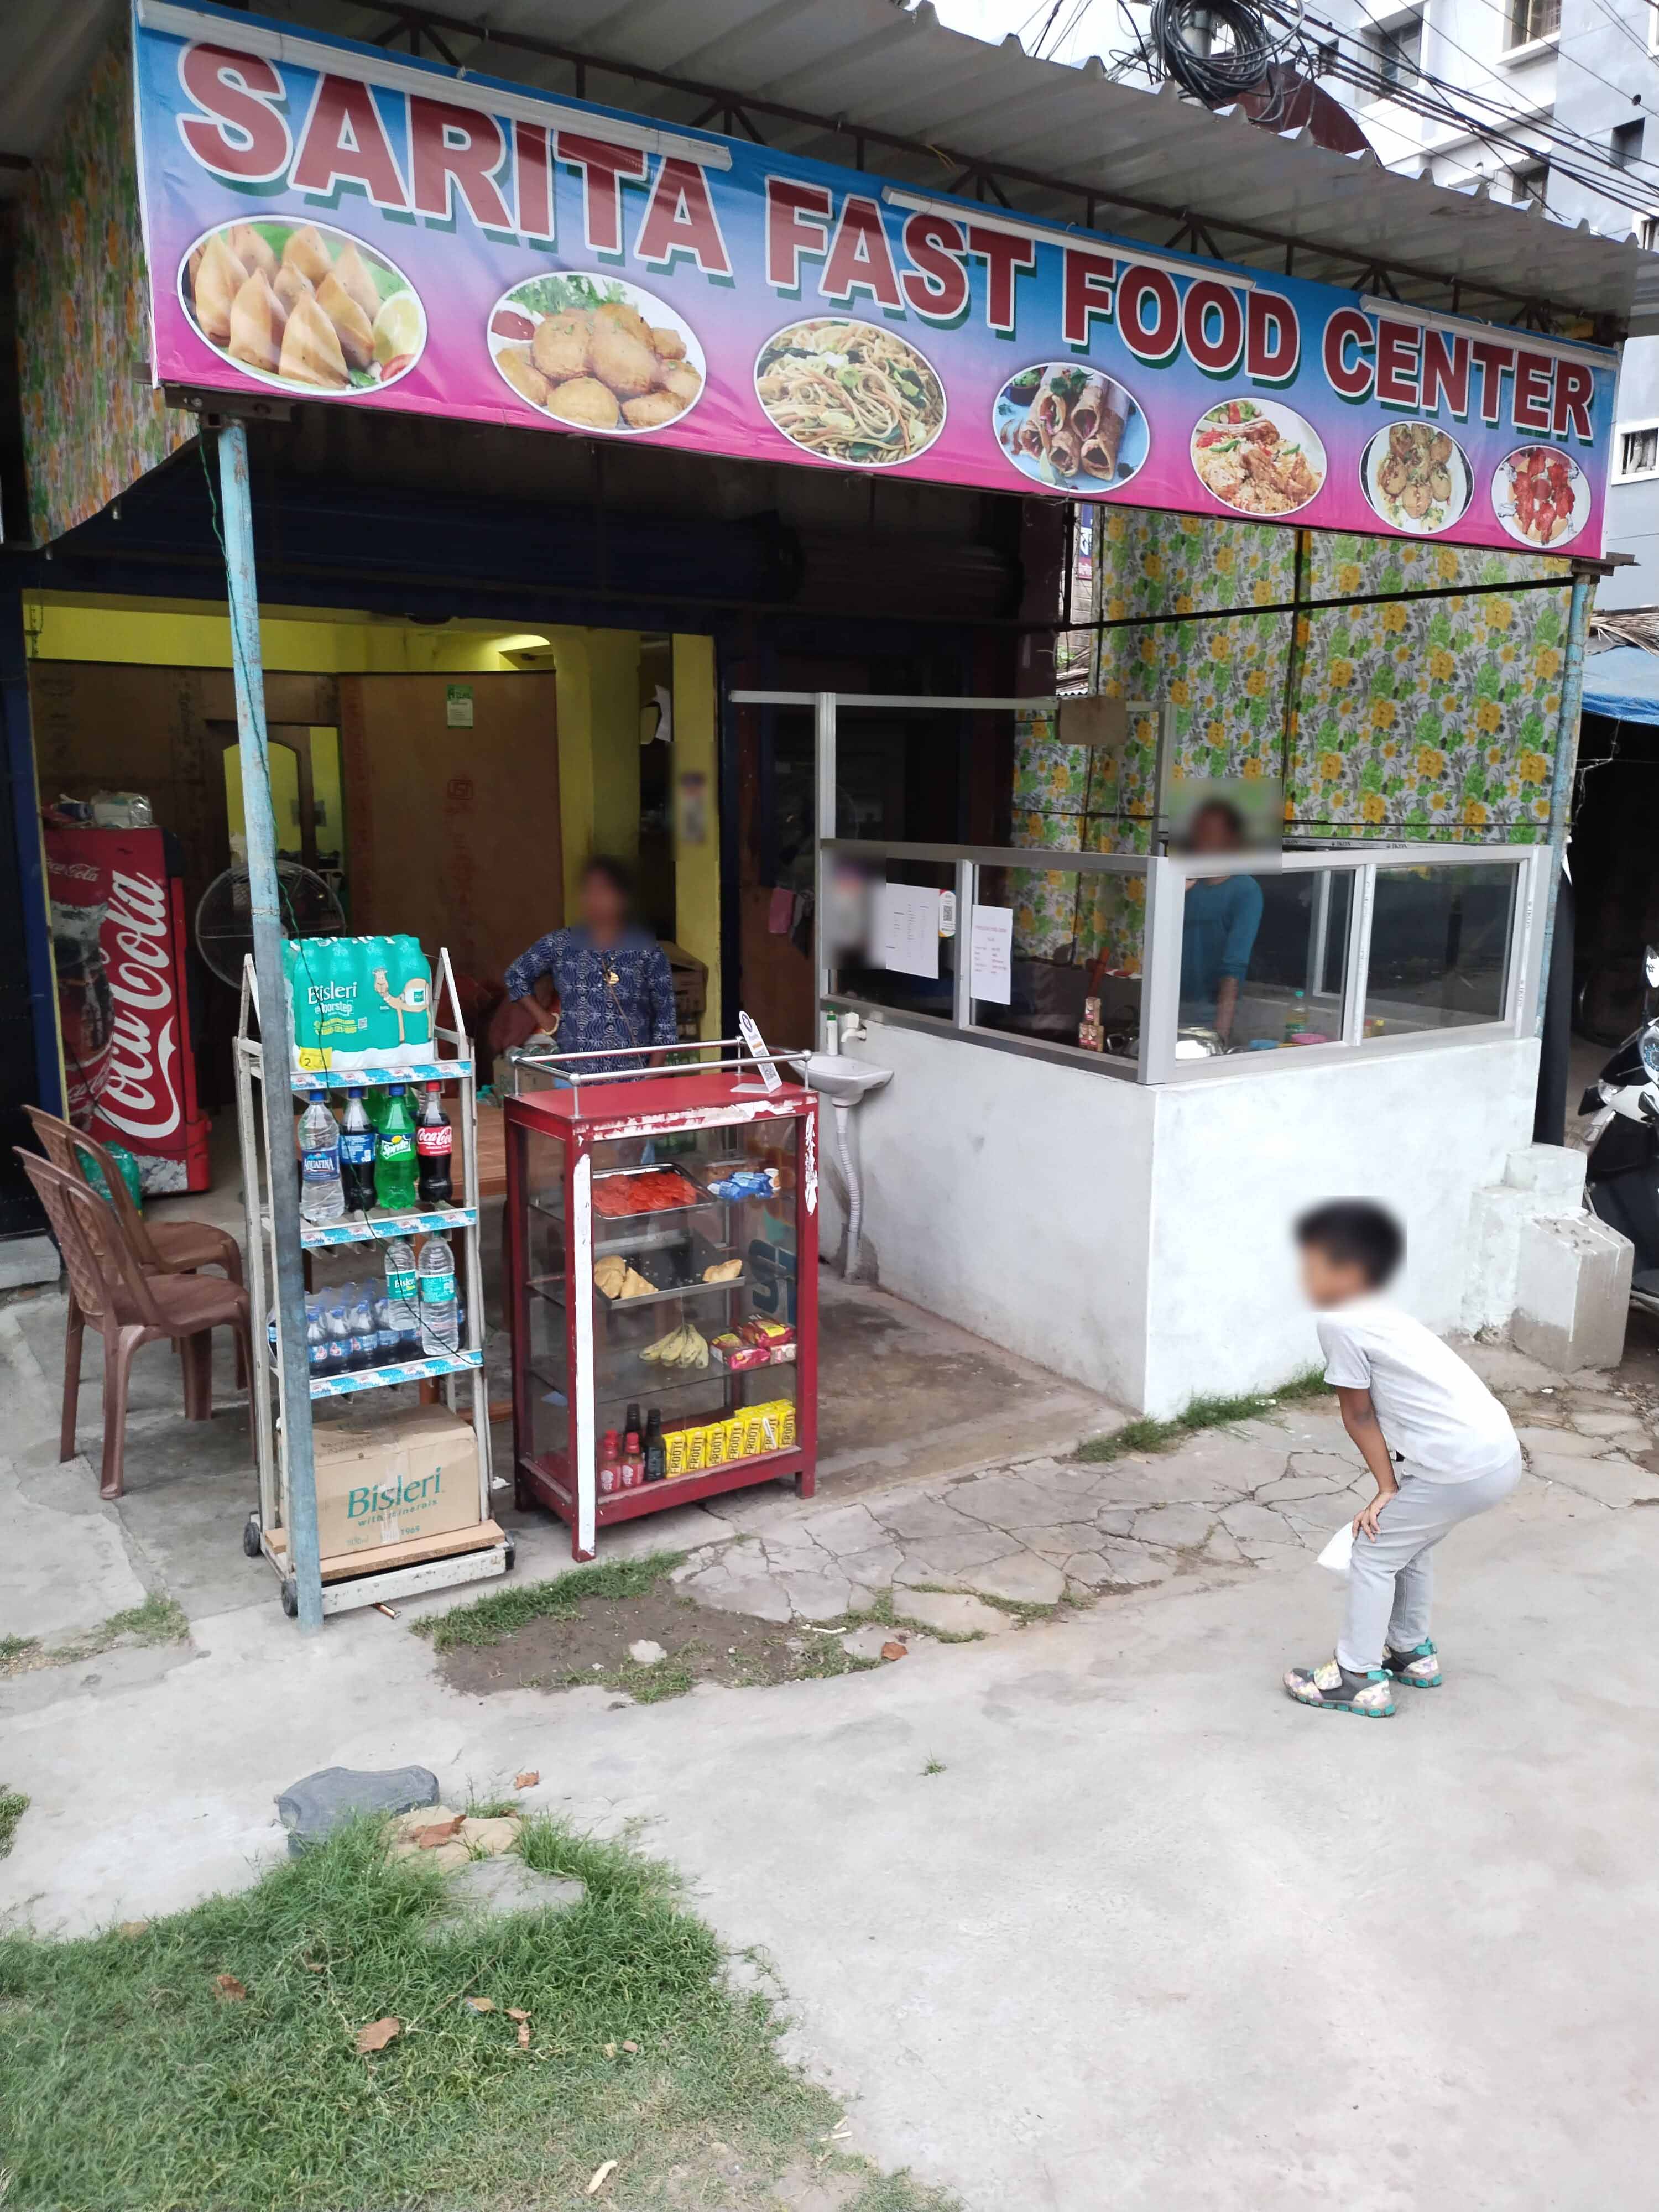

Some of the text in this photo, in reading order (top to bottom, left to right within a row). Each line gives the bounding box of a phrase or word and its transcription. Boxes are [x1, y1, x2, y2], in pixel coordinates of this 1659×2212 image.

[177, 40, 1596, 445] SARITA FAST FOOD CENTER
[307, 980, 358, 1005] Bisleri
[382, 1140, 409, 1157] Sprite
[304, 1157, 335, 1172] AQUAFINA
[764, 1418, 778, 1451] FRTI
[347, 1466, 442, 1519] Bisleri
[358, 1514, 384, 1527] with
